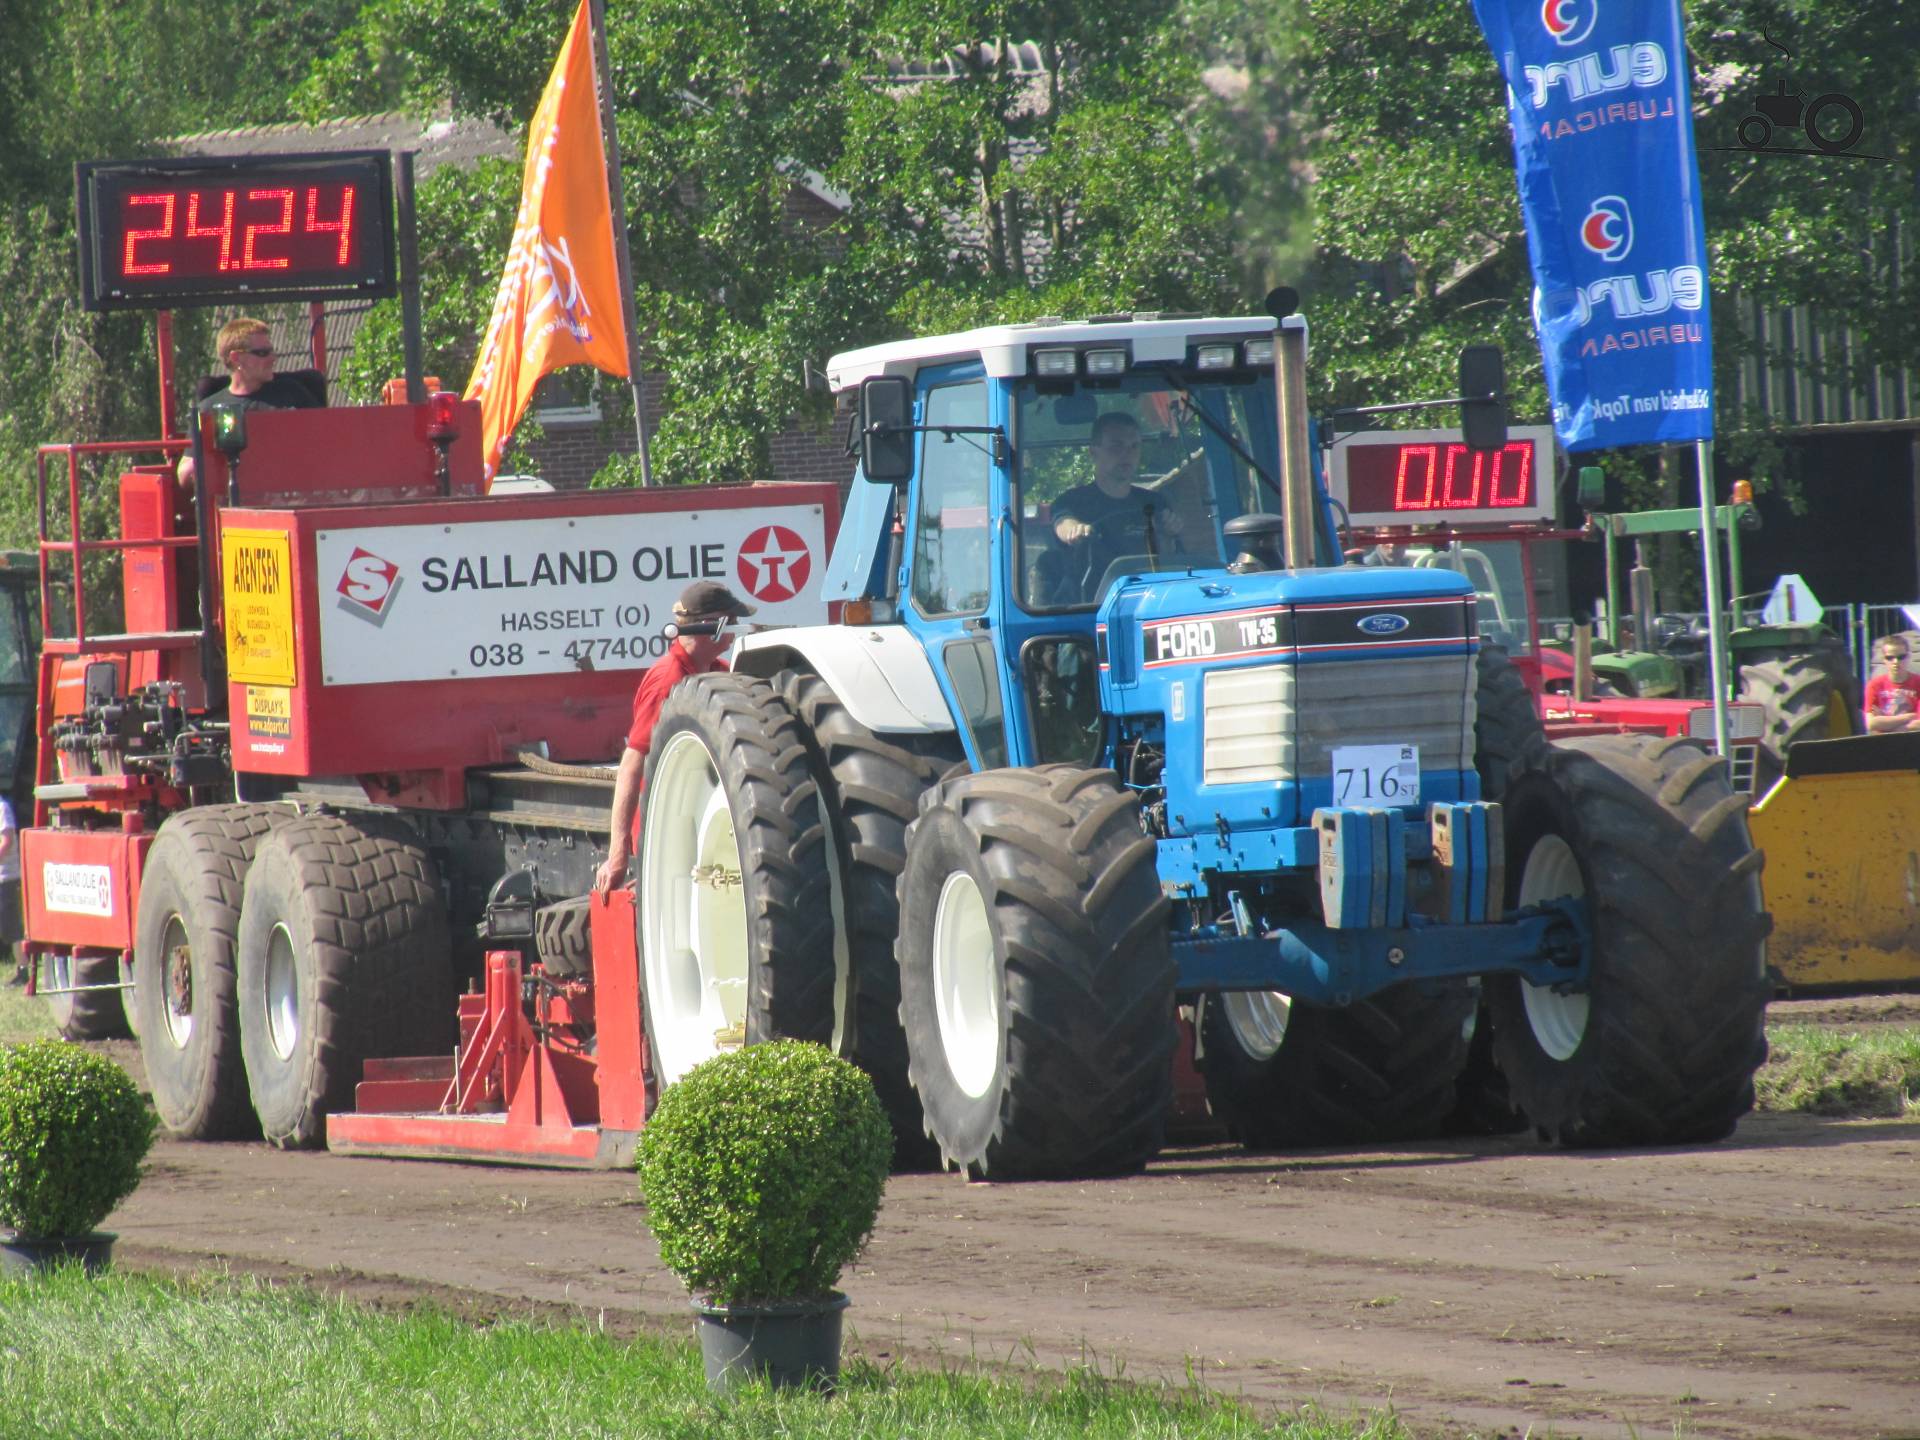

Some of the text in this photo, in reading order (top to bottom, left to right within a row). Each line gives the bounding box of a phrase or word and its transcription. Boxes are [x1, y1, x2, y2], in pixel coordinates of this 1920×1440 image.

[123, 186, 354, 275] 24.24
[1395, 442, 1533, 511] 0.00
[233, 547, 280, 595] ARENTSEN
[421, 543, 727, 593] SALLAND OLIE
[501, 607, 605, 632] HASSELT
[1156, 617, 1278, 660] FORD TW-35
[469, 642, 524, 668] 038
[563, 634, 671, 661] 477400
[1335, 765, 1399, 800] 716
